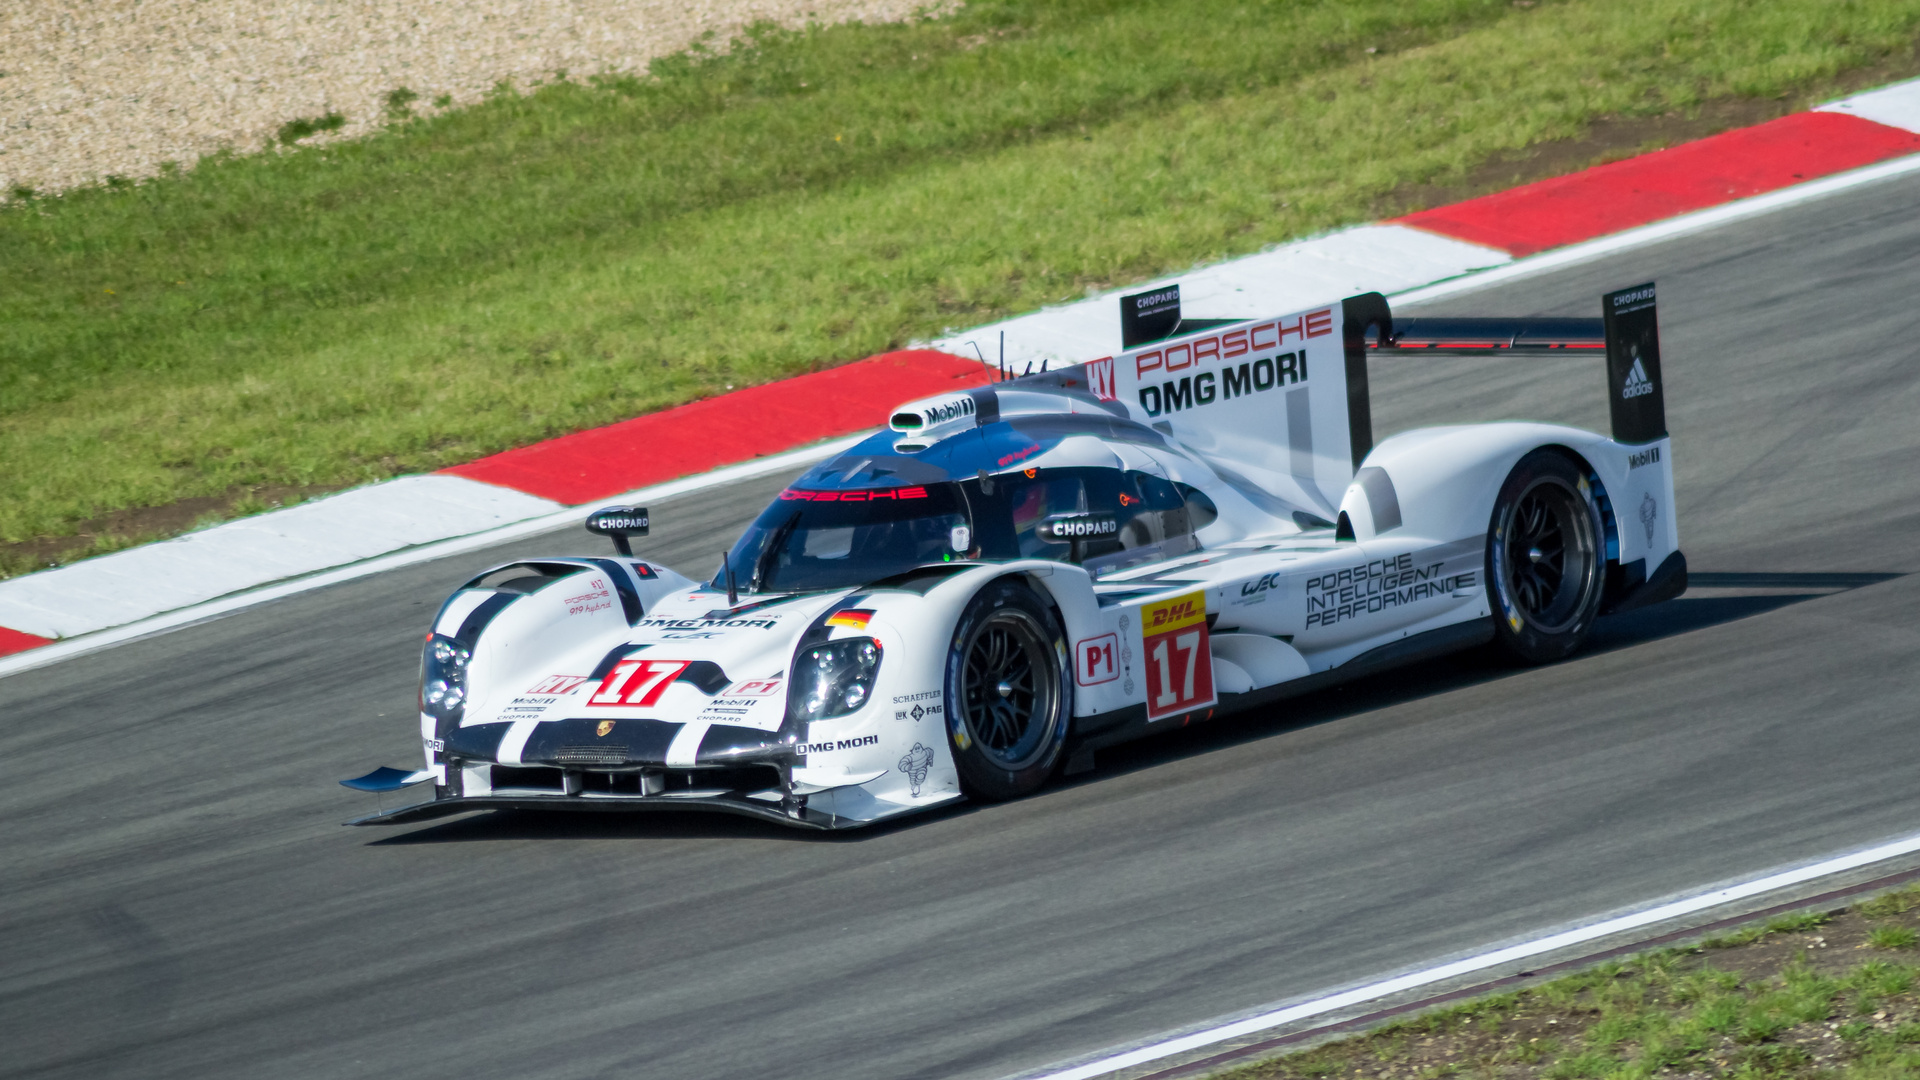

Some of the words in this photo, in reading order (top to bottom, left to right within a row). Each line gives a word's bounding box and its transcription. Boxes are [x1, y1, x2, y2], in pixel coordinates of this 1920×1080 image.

[1137, 290, 1179, 309] CHOPARD
[1613, 288, 1655, 306] CHOPARD
[1136, 309, 1332, 380] PORSCHE
[1086, 359, 1113, 400] HY
[1138, 372, 1216, 418] DMG
[1222, 349, 1308, 400] MORI
[1622, 382, 1653, 399] adidas
[779, 486, 928, 502] ORSCHE
[599, 517, 648, 529] CHOPARD
[1053, 521, 1116, 536] CHOPARD
[1306, 552, 1412, 595] PORSCHE
[1306, 562, 1444, 613] INTELLIGENT
[564, 590, 609, 604] PORSCHE
[1305, 572, 1476, 630] PERFORMANCE
[569, 605, 584, 616] 919
[1152, 601, 1197, 627] DHL
[700, 619, 778, 631] MORI
[1087, 642, 1113, 678] P1
[1153, 631, 1201, 708] 17
[592, 662, 685, 704] 17
[735, 681, 780, 693] P1
[893, 689, 942, 704] SCHAEFFLER
[697, 715, 742, 723] CHOPARD
[926, 705, 943, 715] FAG
[797, 741, 835, 755] DMG
[837, 735, 879, 750] MORI
